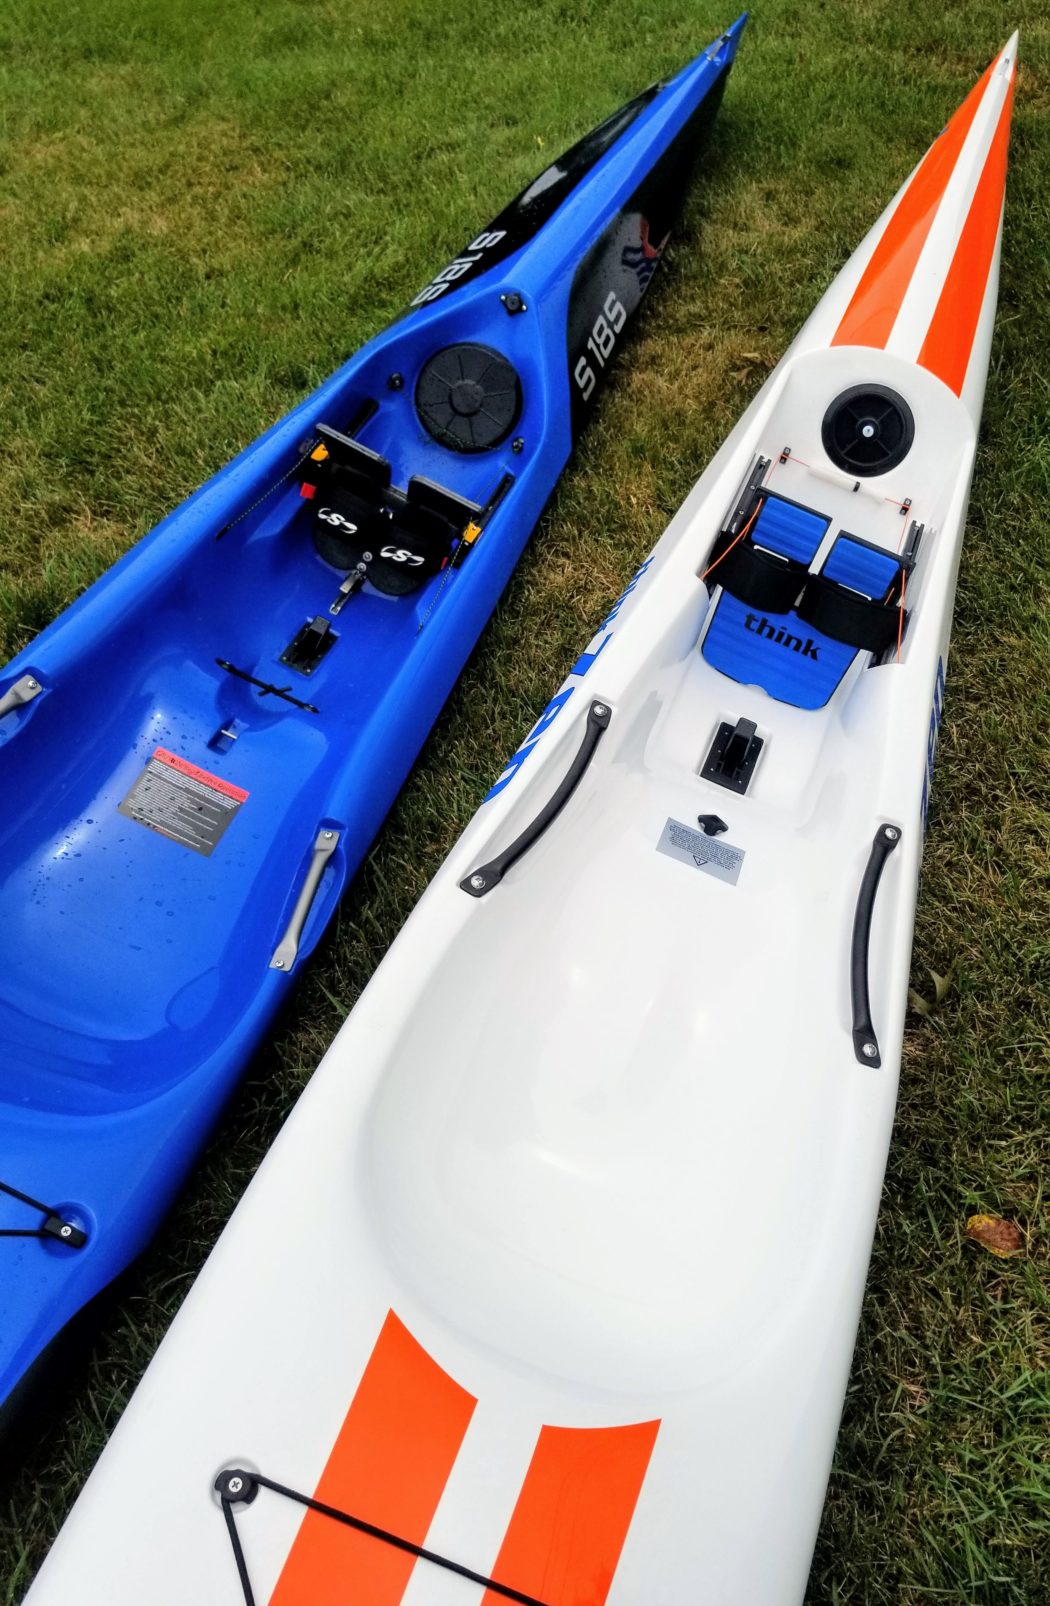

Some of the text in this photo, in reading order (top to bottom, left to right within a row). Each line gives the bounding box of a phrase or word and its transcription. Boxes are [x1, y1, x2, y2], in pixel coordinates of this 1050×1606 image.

[467, 230, 507, 250] S
[574, 291, 627, 402] S 18S
[744, 612, 821, 662] think
